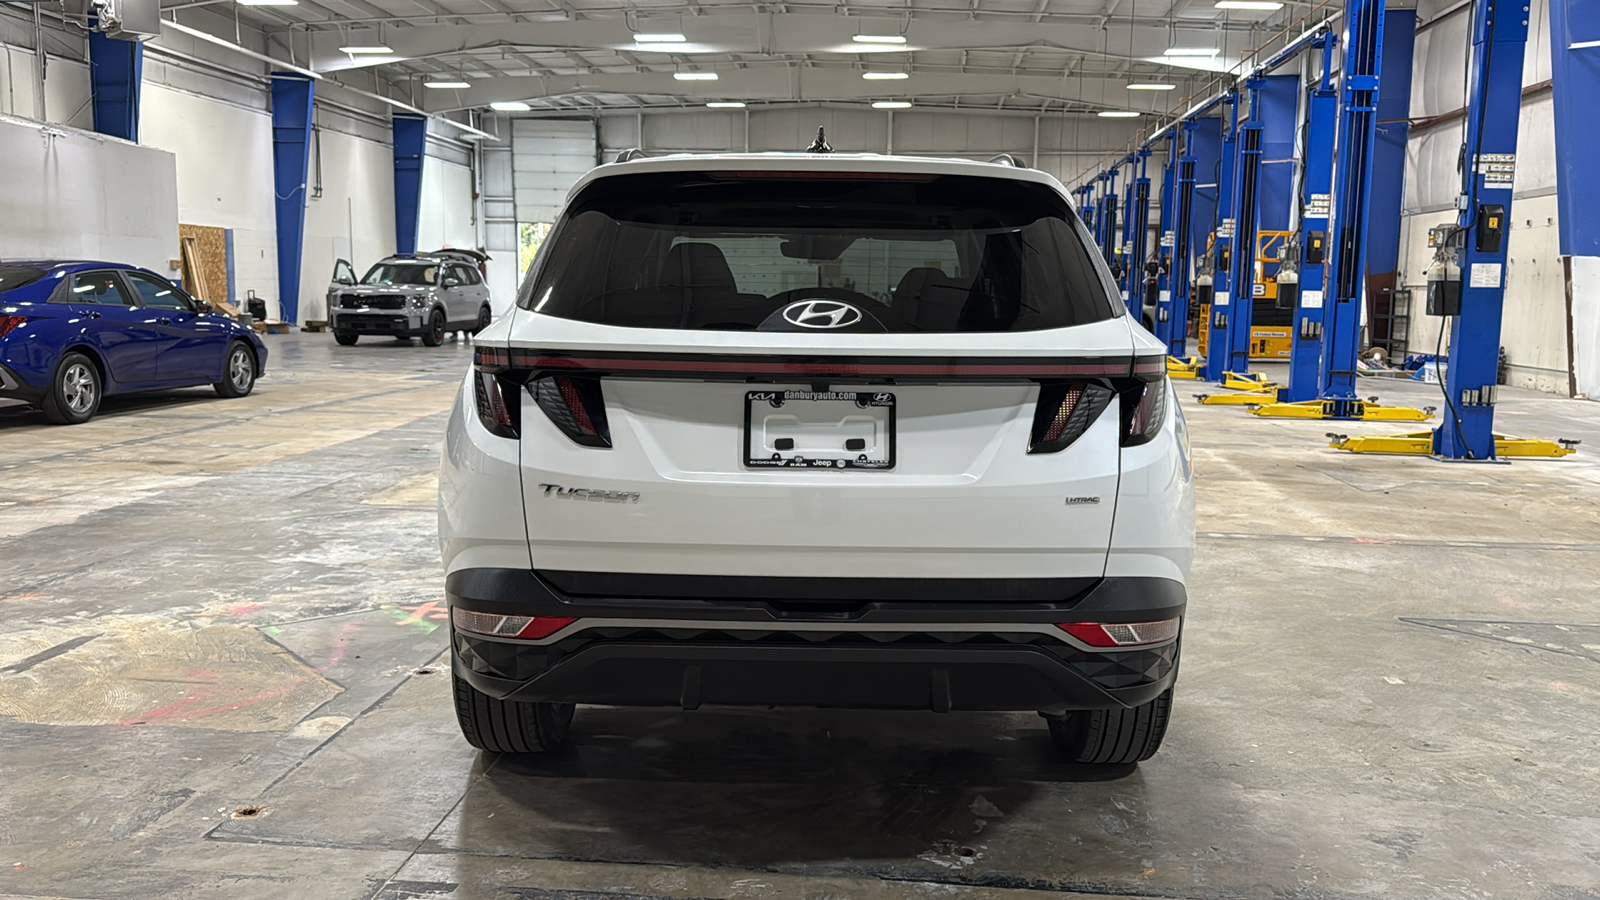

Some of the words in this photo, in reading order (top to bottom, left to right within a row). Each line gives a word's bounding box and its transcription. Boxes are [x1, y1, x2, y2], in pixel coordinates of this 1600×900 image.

[784, 390, 857, 400] danburyauto.com
[812, 459, 832, 467] Jeep
[538, 483, 640, 501] TUCSON
